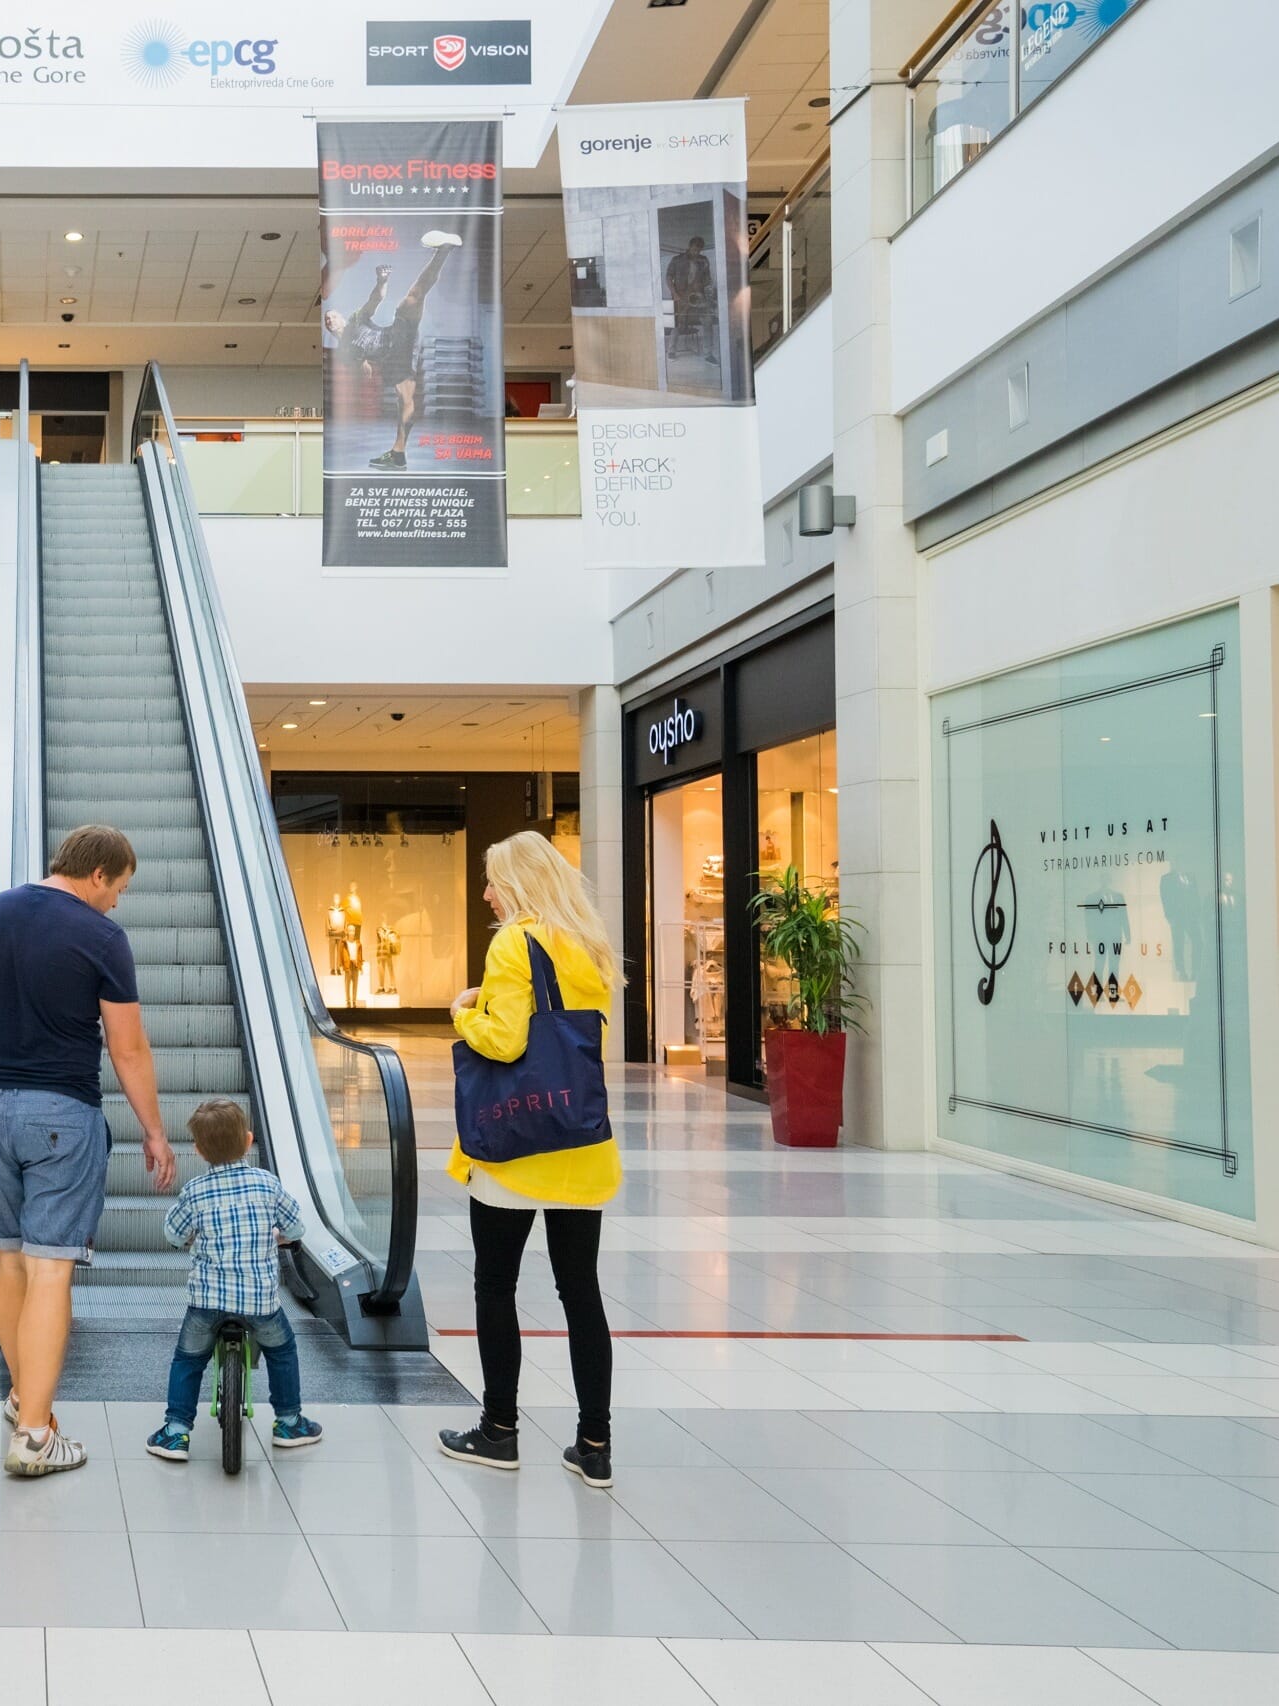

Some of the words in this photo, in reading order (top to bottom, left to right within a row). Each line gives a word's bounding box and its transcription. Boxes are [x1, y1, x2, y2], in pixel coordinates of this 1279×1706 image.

[1021, 3, 1070, 62] LEGEND
[187, 39, 279, 75] epcg
[368, 45, 428, 57] SPORT
[470, 44, 529, 57] VISION
[33, 66, 87, 84] Gore
[210, 77, 285, 90] Elektroprivreda
[286, 77, 309, 89] Crne
[311, 77, 335, 89] Gore
[580, 134, 652, 155] gorenje
[322, 160, 403, 180] Benex
[407, 160, 497, 180] Fitness
[350, 183, 404, 197] Unique
[591, 422, 687, 440] DESIGNED
[434, 447, 452, 459] SA
[456, 447, 493, 460] VAMA
[593, 441, 617, 457] BY
[595, 475, 673, 491] DEFINED
[350, 487, 364, 497] ZA
[367, 487, 389, 497] SVE
[391, 487, 469, 497] INFORMACIJE:
[344, 498, 381, 507] BENEX
[383, 498, 428, 507] FITNESS
[431, 498, 475, 508] UNIQUE
[596, 494, 620, 509] BY
[359, 508, 381, 517] THE
[383, 508, 427, 517] CAPITAL
[430, 508, 465, 518] PLAZA
[596, 511, 641, 527] YOU.
[356, 518, 377, 528] TEL.
[381, 518, 403, 528] 067
[413, 518, 435, 528] 055
[446, 519, 468, 528] 555
[357, 529, 467, 538] www.benexfitness.me
[649, 698, 695, 765] oysho
[1040, 826, 1090, 843] VISIT
[1107, 822, 1128, 836] US
[1146, 817, 1168, 833] AT
[1043, 850, 1166, 871] STRADIVARIUS.COM
[1048, 942, 1122, 955] FOLLOW
[1140, 943, 1163, 957] US
[478, 1089, 572, 1124] ESPRIT
